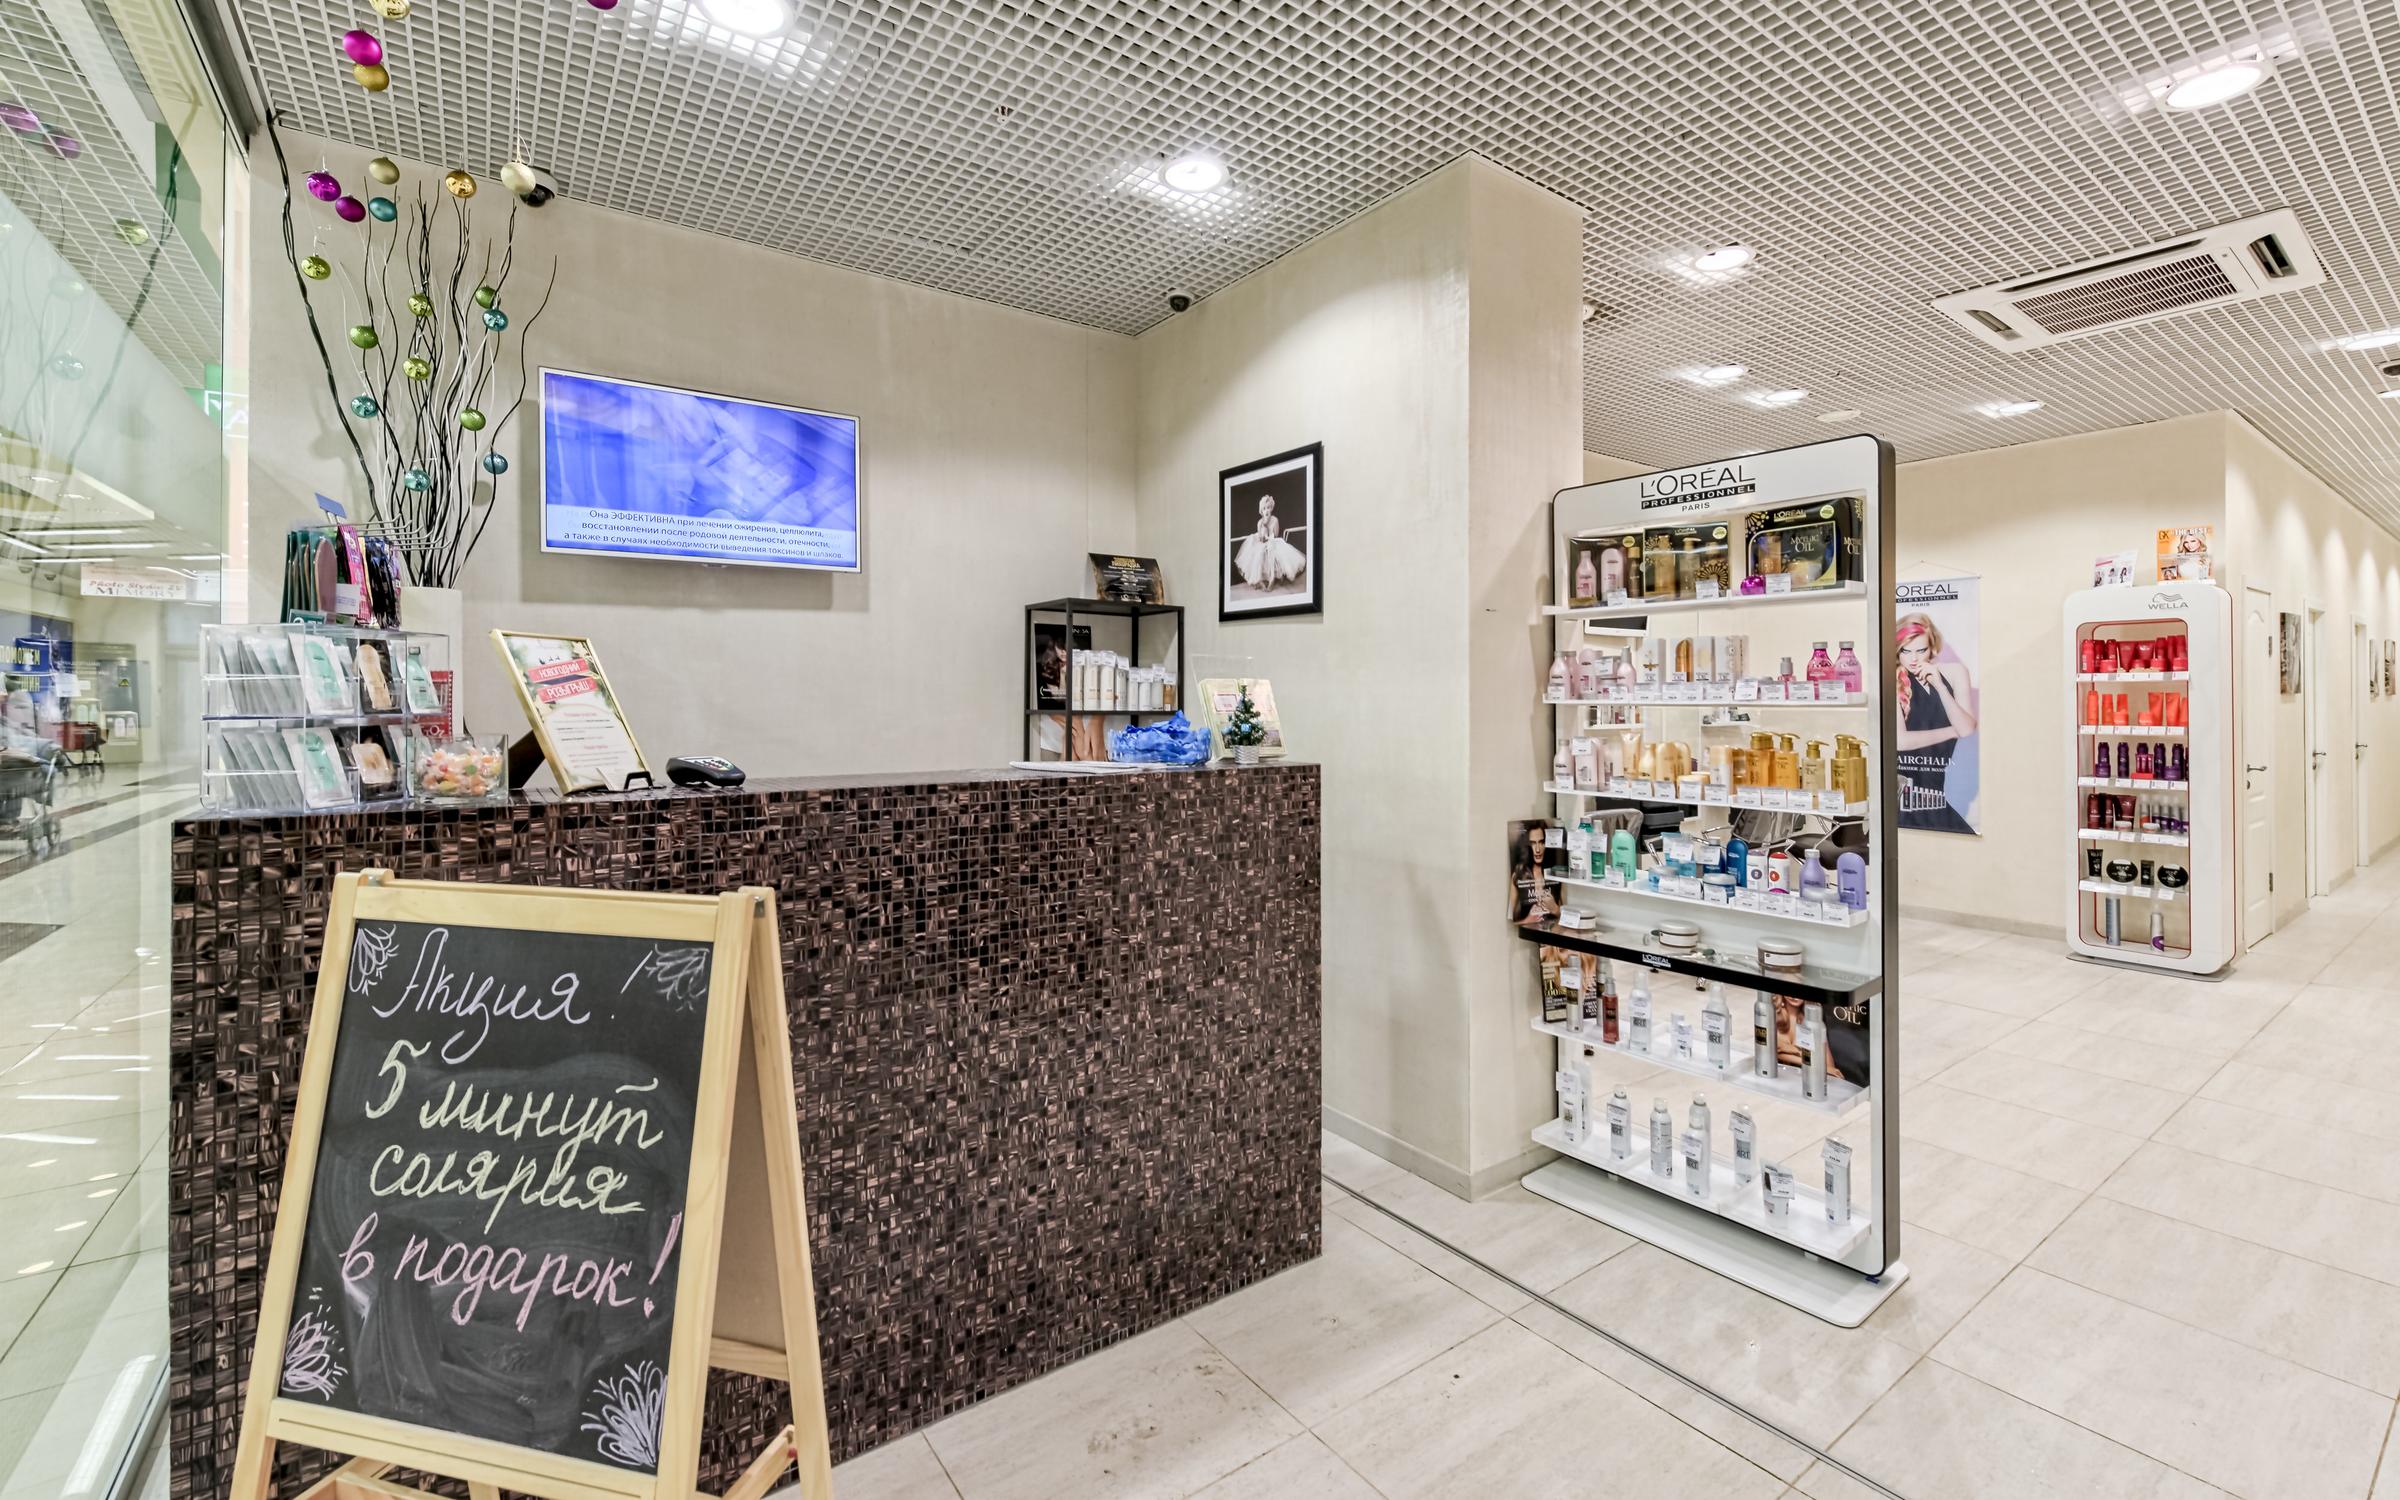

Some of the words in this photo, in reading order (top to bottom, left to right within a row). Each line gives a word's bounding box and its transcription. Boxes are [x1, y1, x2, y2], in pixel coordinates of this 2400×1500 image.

[1641, 464, 1756, 498] L'ORÉAL
[1641, 484, 1755, 509] PROFESSIONNEL
[1681, 502, 1711, 512] PARIS
[581, 522, 659, 535] восстановлении
[661, 528, 688, 537] после
[690, 530, 728, 540] родовой
[729, 533, 787, 545] деятельности,
[788, 539, 831, 549] отечности,
[589, 510, 609, 519] Она
[611, 511, 675, 525] ЭФФЕКТИВНА
[677, 519, 695, 528] при
[696, 520, 733, 530] лечении
[734, 523, 778, 535] ожирения,
[779, 528, 824, 538] целлюлита,
[572, 533, 601, 542] также
[611, 535, 648, 546] случаях
[649, 538, 720, 551] необходимости
[720, 543, 767, 554] выведения
[768, 548, 806, 557] токсинов
[2148, 602, 2189, 610] WELLA
[539, 662, 581, 678] НОВОГОДНИЙ
[546, 680, 590, 699] РОЗЫГРЫШ
[1833, 1006, 1861, 1025] OIL
[366, 1040, 431, 1119] 5
[419, 1077, 664, 1174] минут
[370, 1144, 646, 1234] солярия
[338, 1212, 379, 1293] в
[394, 1211, 683, 1332] подарок!
